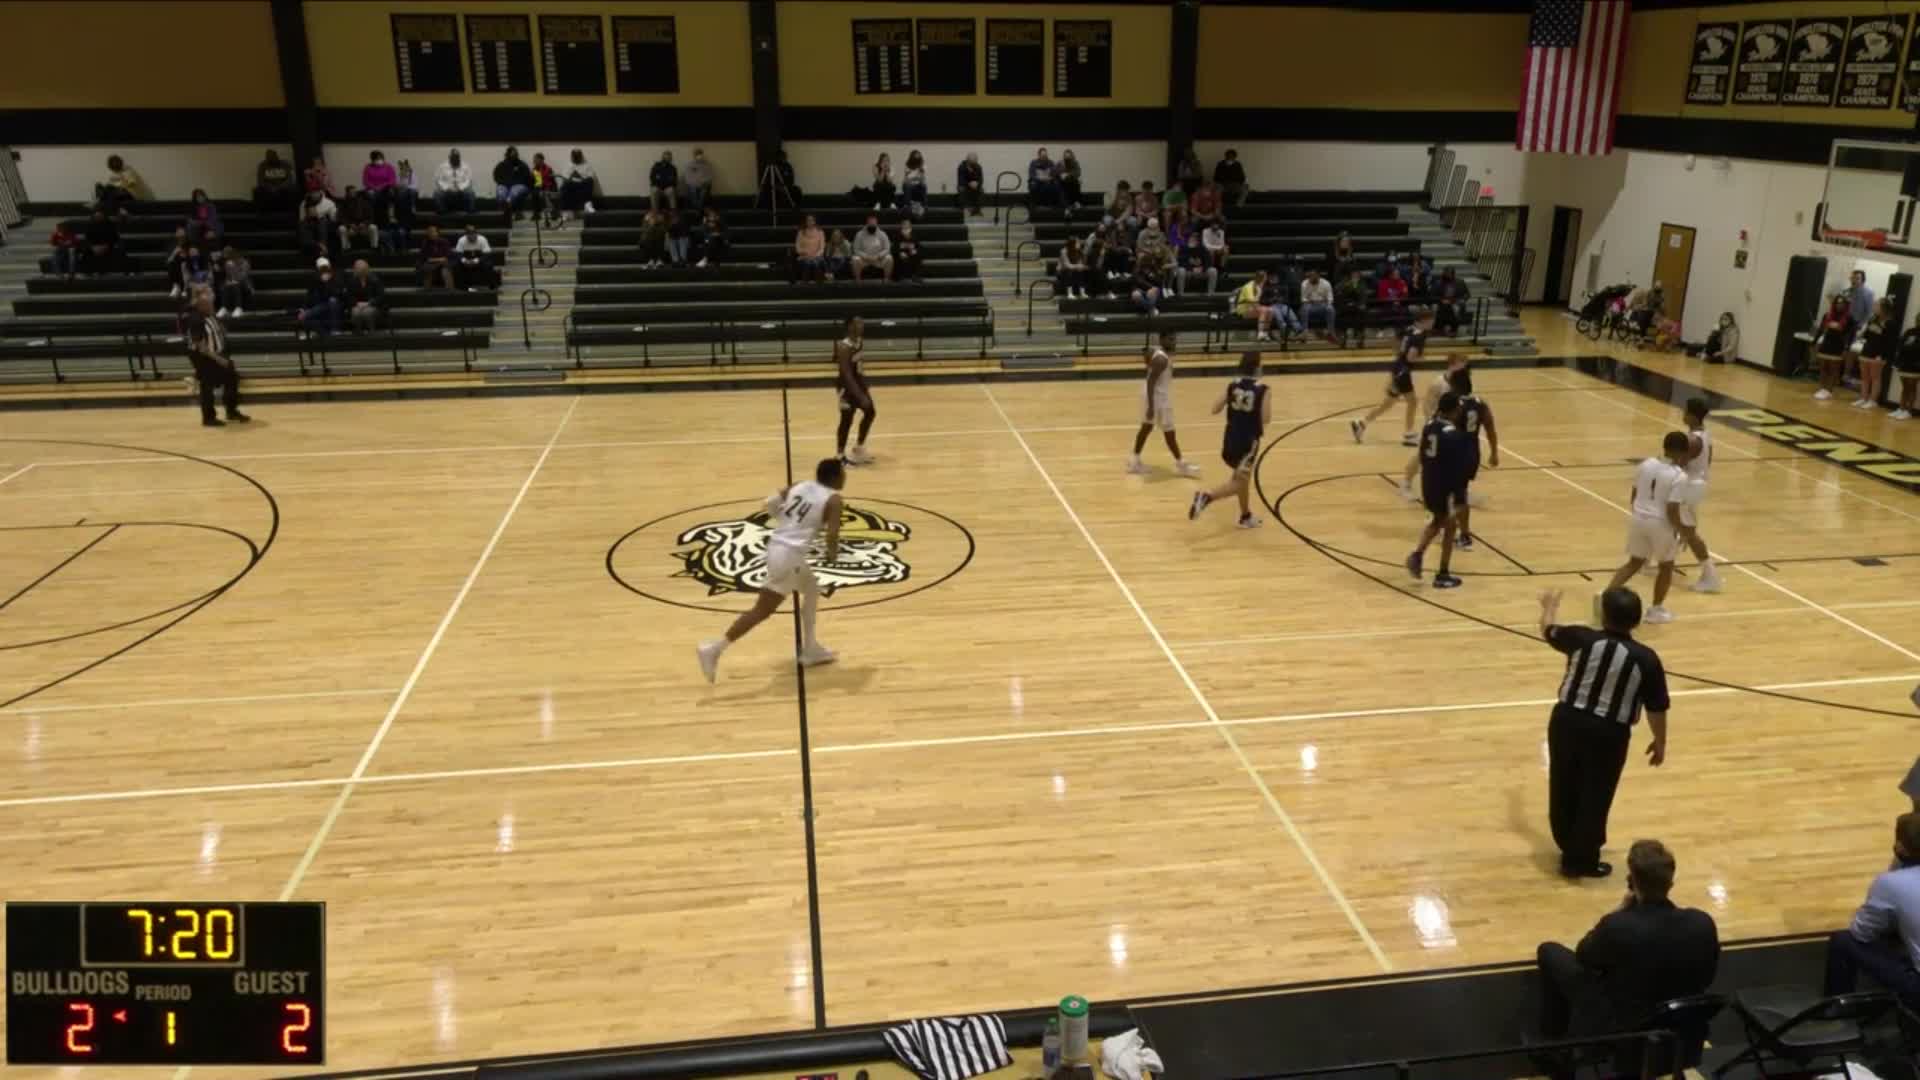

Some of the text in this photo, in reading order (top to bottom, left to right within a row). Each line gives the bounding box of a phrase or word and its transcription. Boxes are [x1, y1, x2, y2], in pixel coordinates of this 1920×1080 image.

[1840, 96, 1889, 105] CHAMPION
[1231, 388, 1255, 413] 33
[1425, 434, 1438, 457] 3
[785, 495, 812, 523] 24
